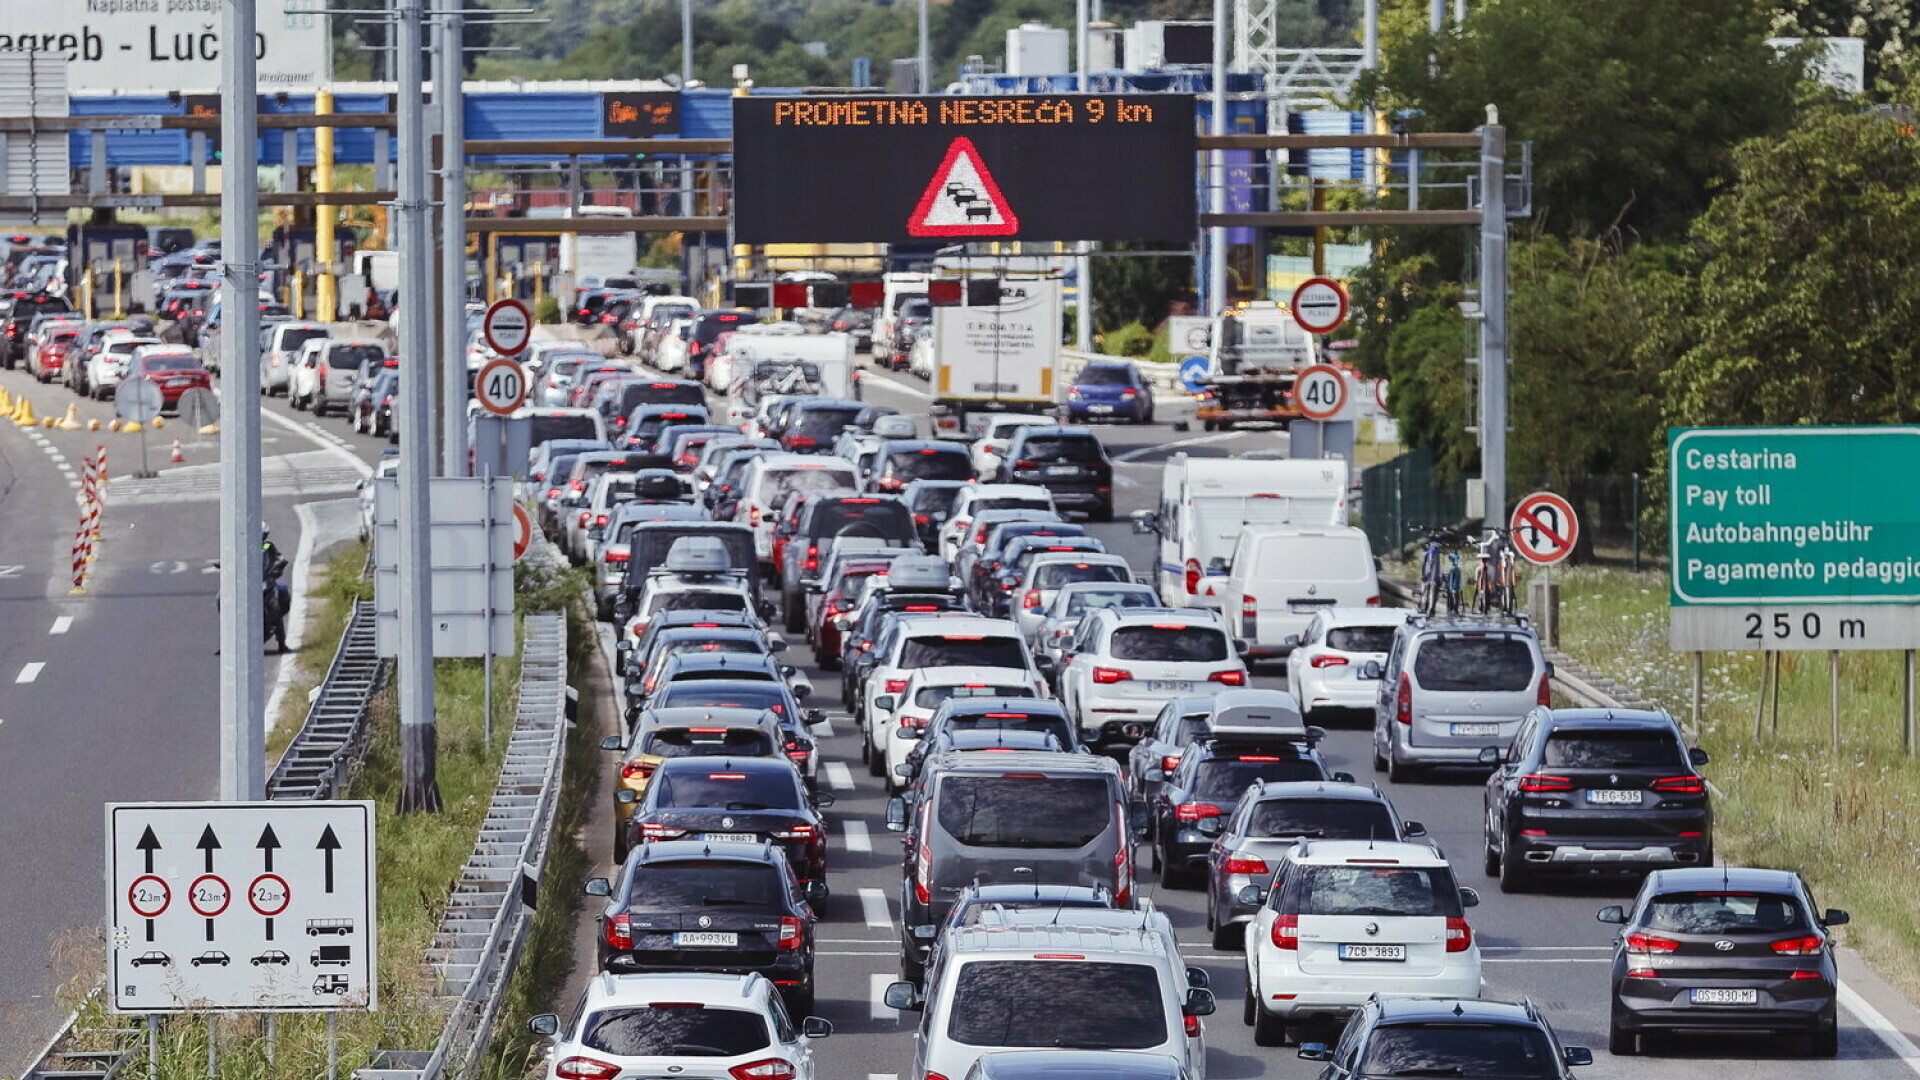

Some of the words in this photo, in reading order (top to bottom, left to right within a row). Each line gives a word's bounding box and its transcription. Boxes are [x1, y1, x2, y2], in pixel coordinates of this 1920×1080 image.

[774, 101, 928, 126] PROMETNA
[940, 100, 1073, 125] NESREĆA
[1084, 100, 1105, 124] 9
[1117, 99, 1153, 123] km
[489, 374, 517, 400] 40
[1306, 380, 1336, 405] 40
[1686, 448, 1797, 470] Cestarina
[1686, 484, 1728, 511] Pay
[1736, 484, 1771, 505] toll
[1686, 521, 1874, 547] Autobahngebühr
[1687, 558, 1816, 585] Pagamento
[1745, 612, 1821, 640] 250
[1840, 616, 1866, 639] m
